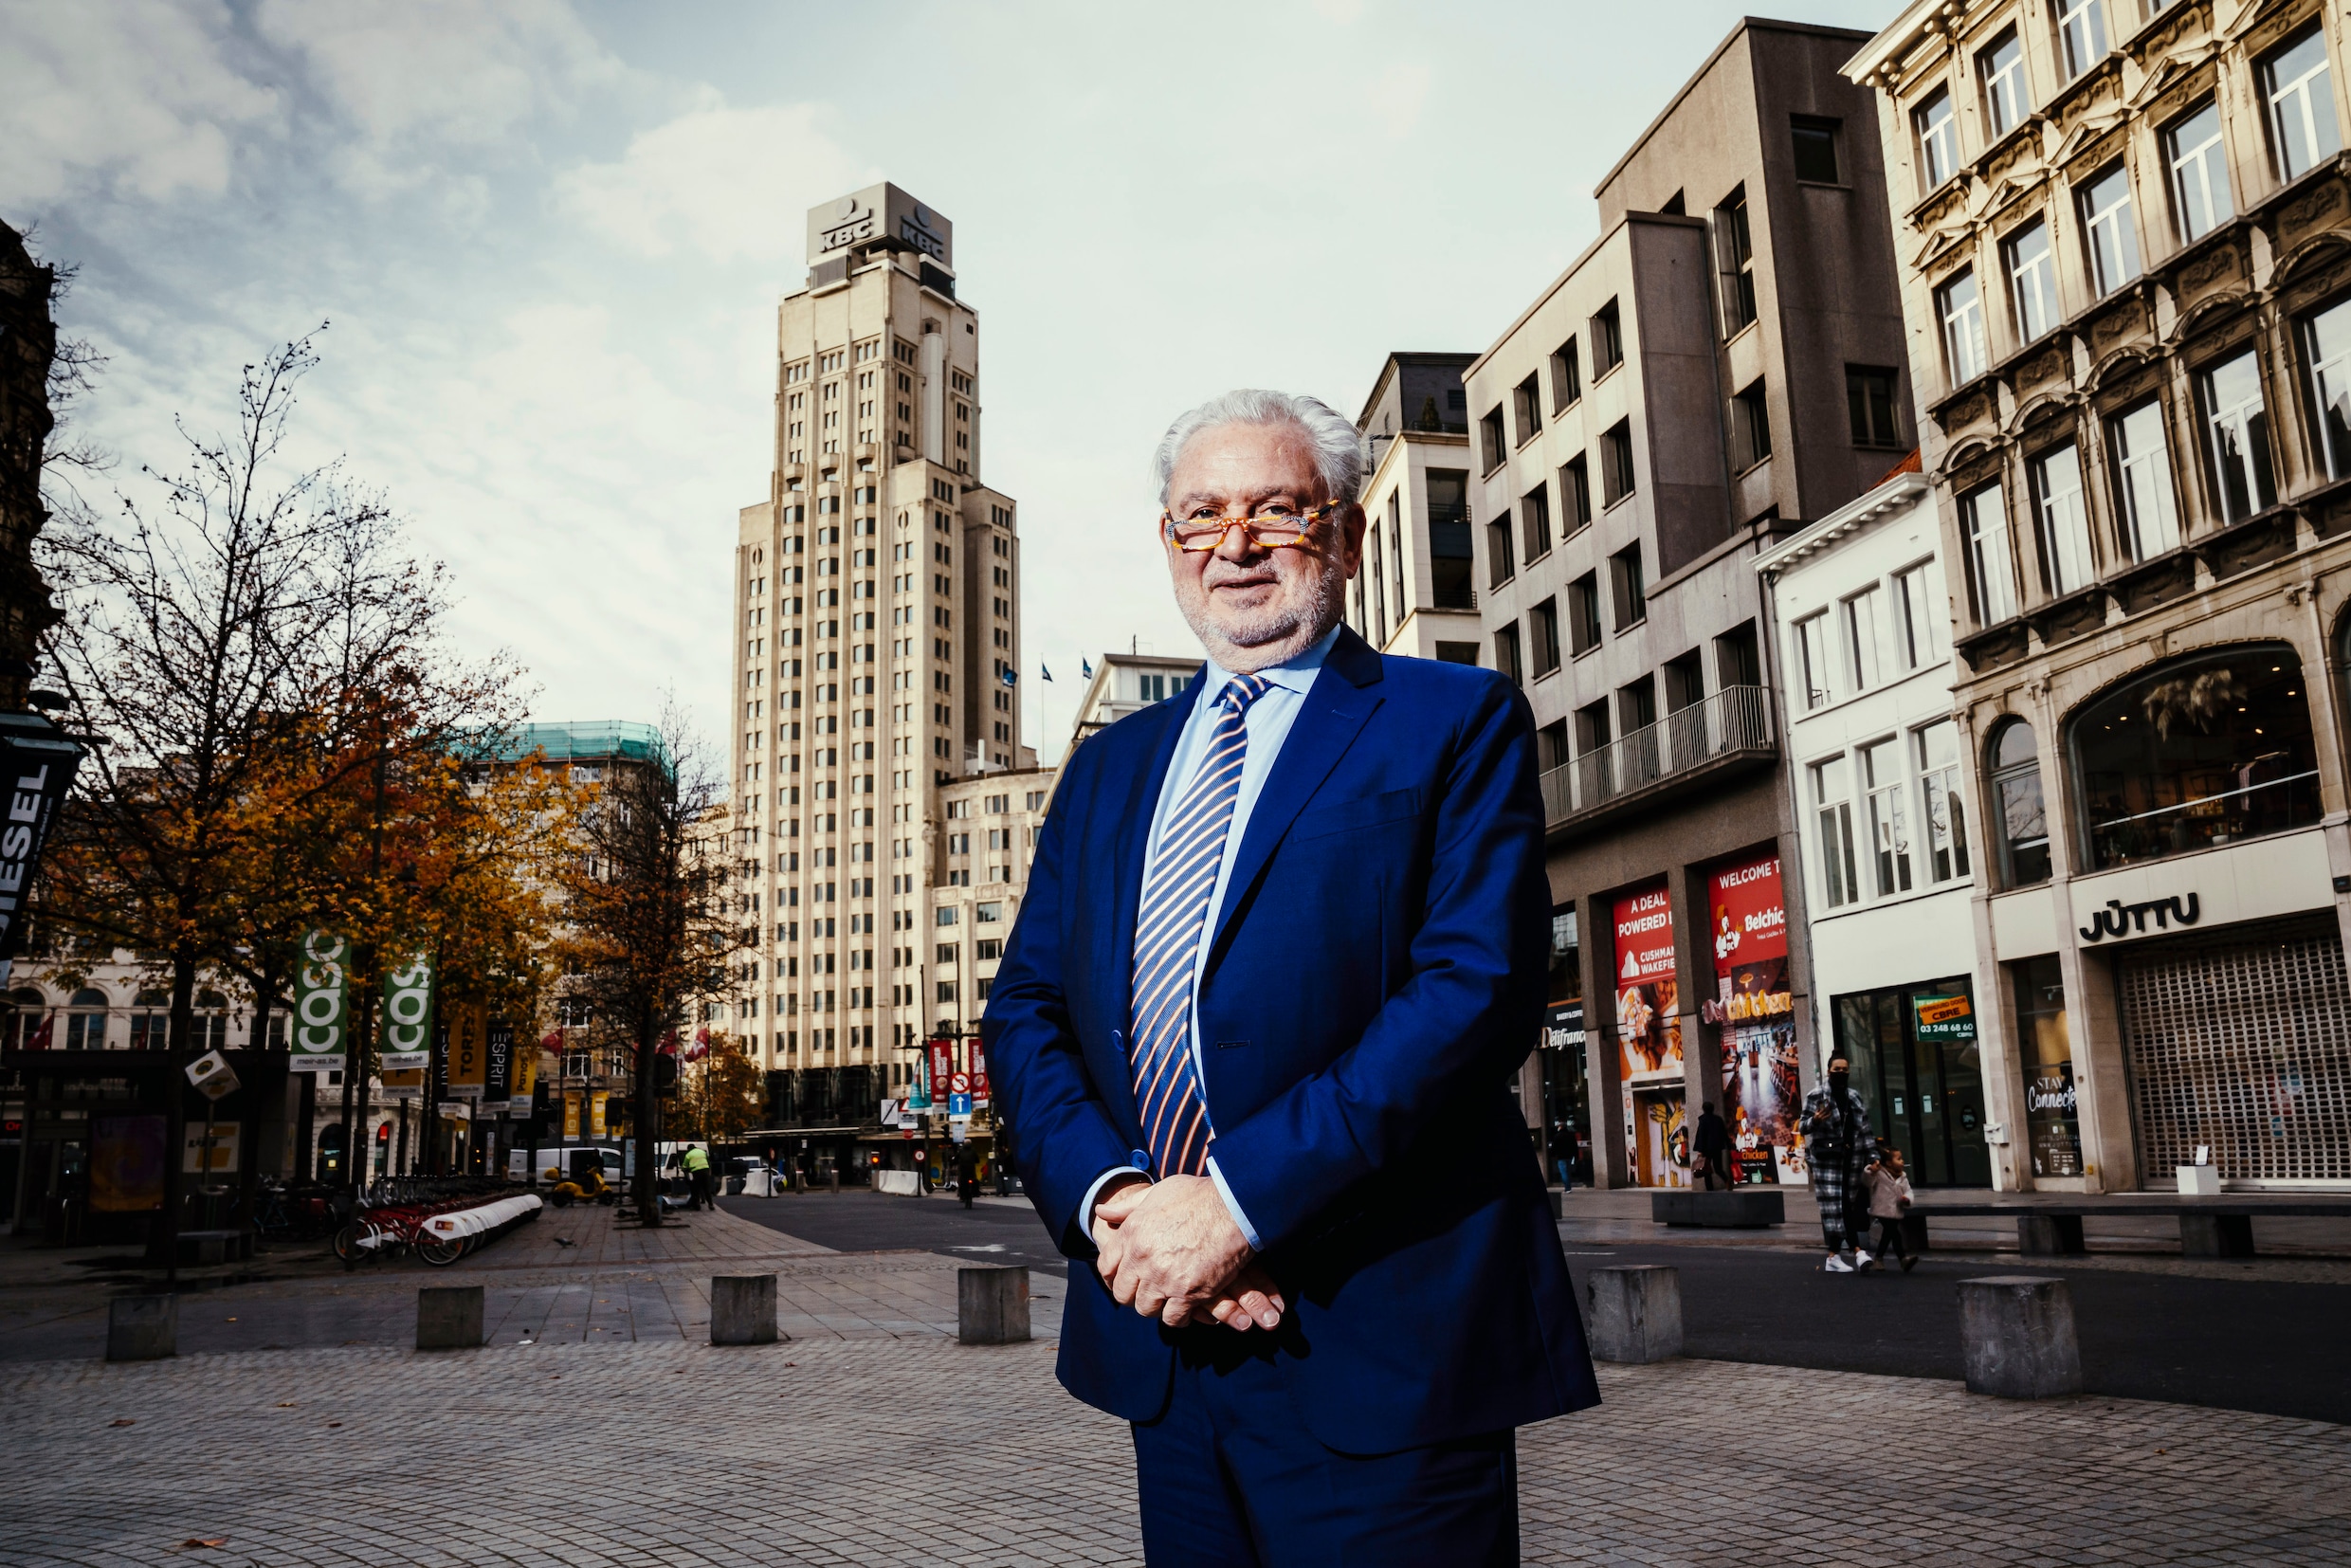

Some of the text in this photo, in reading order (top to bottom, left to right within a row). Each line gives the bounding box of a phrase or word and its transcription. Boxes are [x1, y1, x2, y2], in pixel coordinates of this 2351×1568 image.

[819, 221, 873, 253] KBC
[901, 223, 944, 263] KBC
[1719, 862, 1772, 889] WELCOME
[1631, 892, 1667, 914] A DEAL
[1618, 912, 1667, 938] POWERED
[1640, 957, 1676, 975] WAKEFIE
[1932, 1007, 1961, 1021] CBRE
[1920, 1025, 1931, 1033] 03
[1933, 1024, 1949, 1032] 248
[1962, 1023, 1974, 1031] 60
[490, 1032, 511, 1088] ESPRIT
